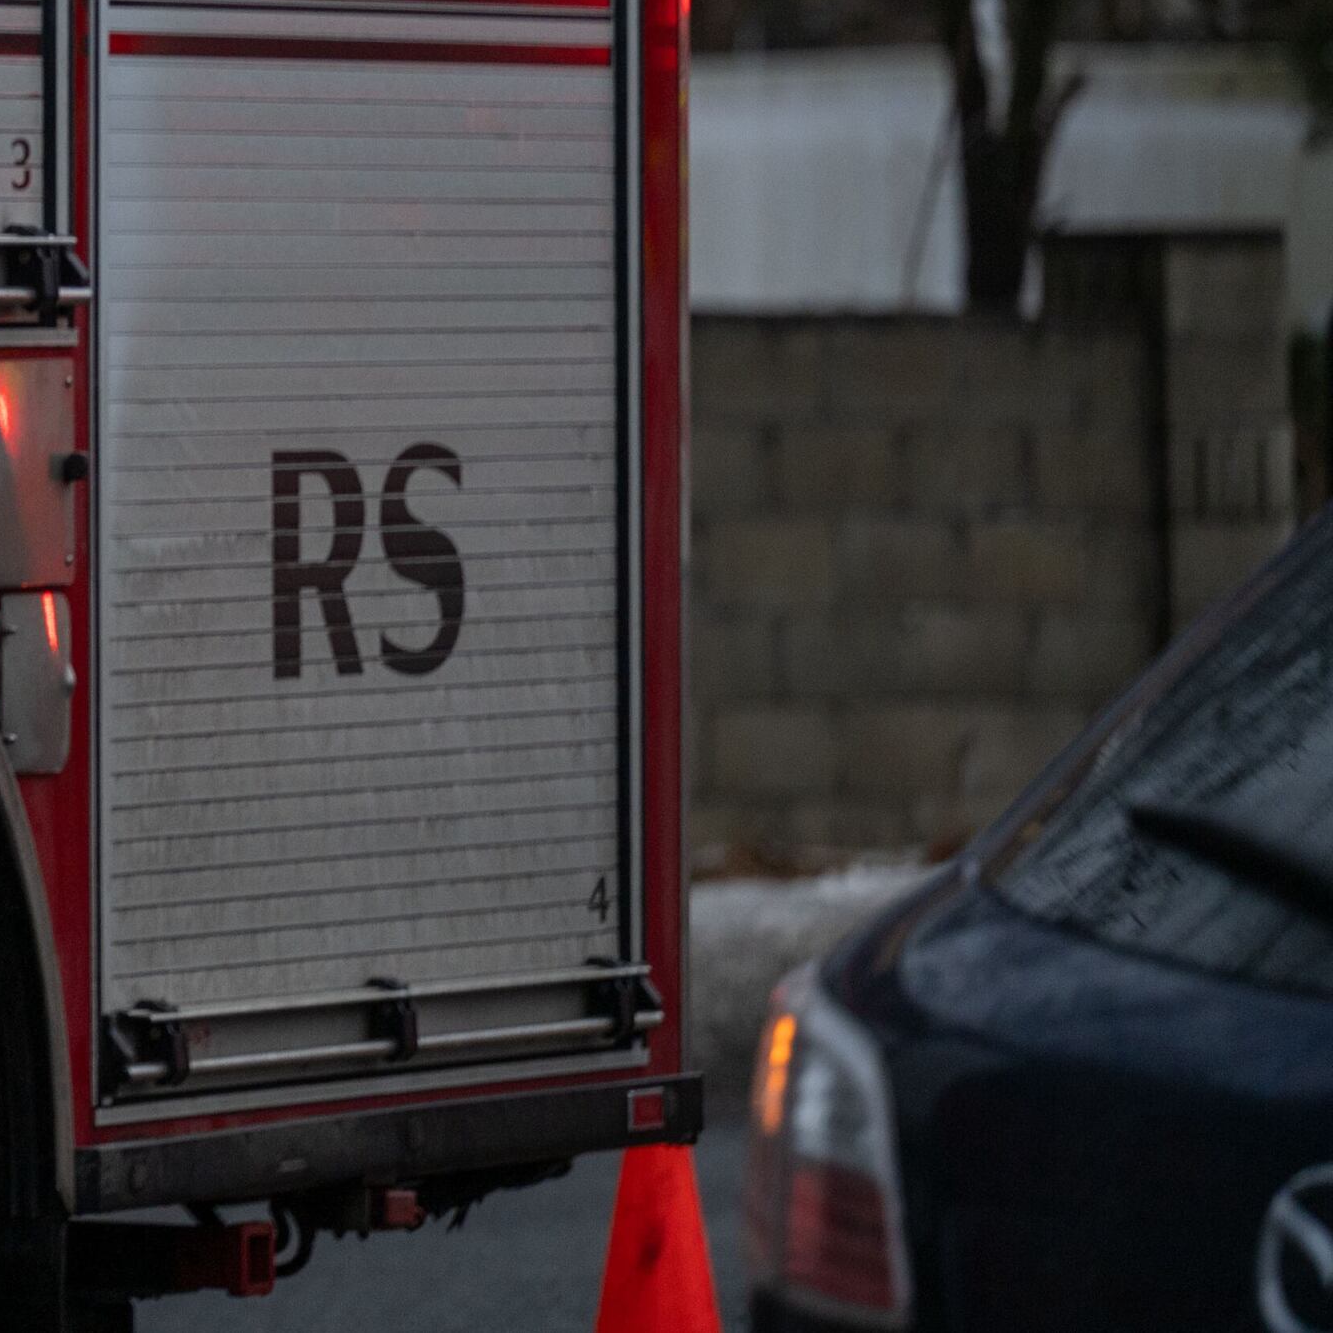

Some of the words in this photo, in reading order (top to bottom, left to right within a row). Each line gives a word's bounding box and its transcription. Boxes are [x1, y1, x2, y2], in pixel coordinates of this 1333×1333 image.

[12, 138, 31, 189] 3
[271, 442, 465, 679] RS
[587, 875, 610, 923] 4
